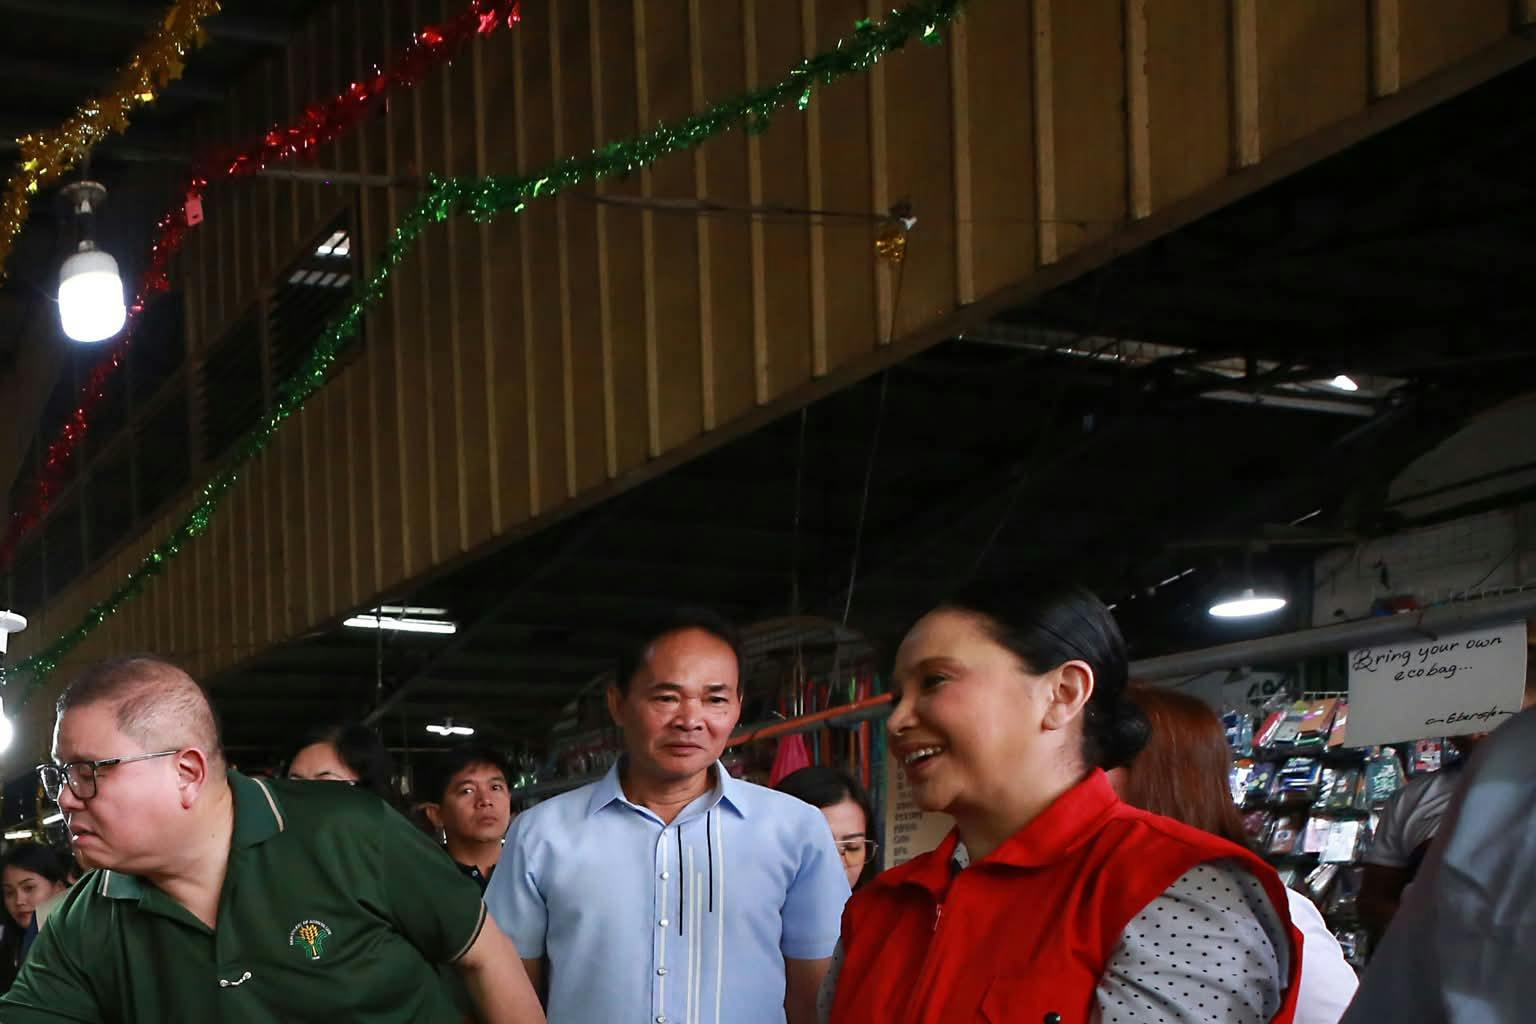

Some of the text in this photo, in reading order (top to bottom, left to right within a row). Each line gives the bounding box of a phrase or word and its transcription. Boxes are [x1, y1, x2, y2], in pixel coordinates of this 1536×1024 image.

[1352, 636, 1503, 673] Bring your own
